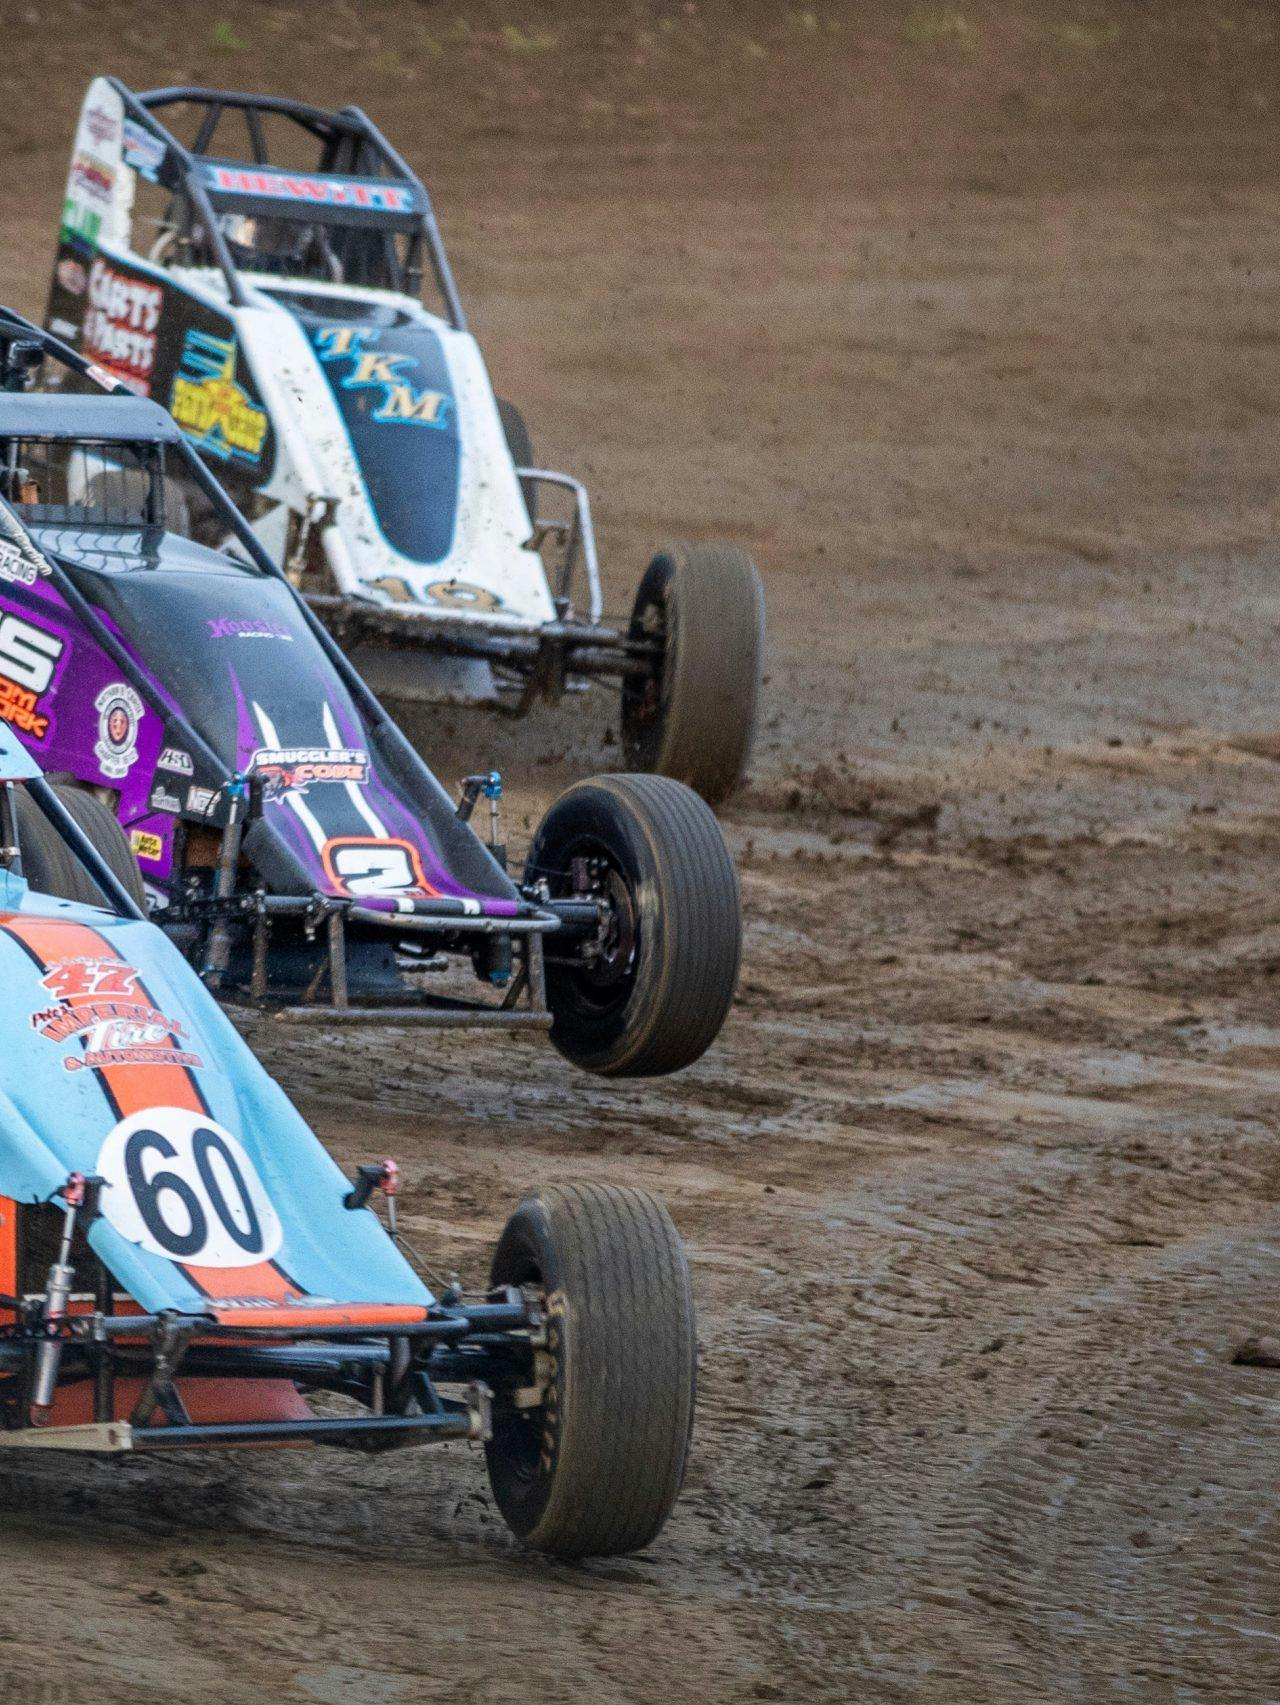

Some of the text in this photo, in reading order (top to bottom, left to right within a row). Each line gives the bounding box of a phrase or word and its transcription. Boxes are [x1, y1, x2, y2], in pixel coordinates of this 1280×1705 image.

[255, 751, 367, 766] SMUGGLER'S
[335, 849, 426, 896] 2
[40, 1002, 190, 1042] IMPERIAL
[124, 1126, 265, 1258] 60
